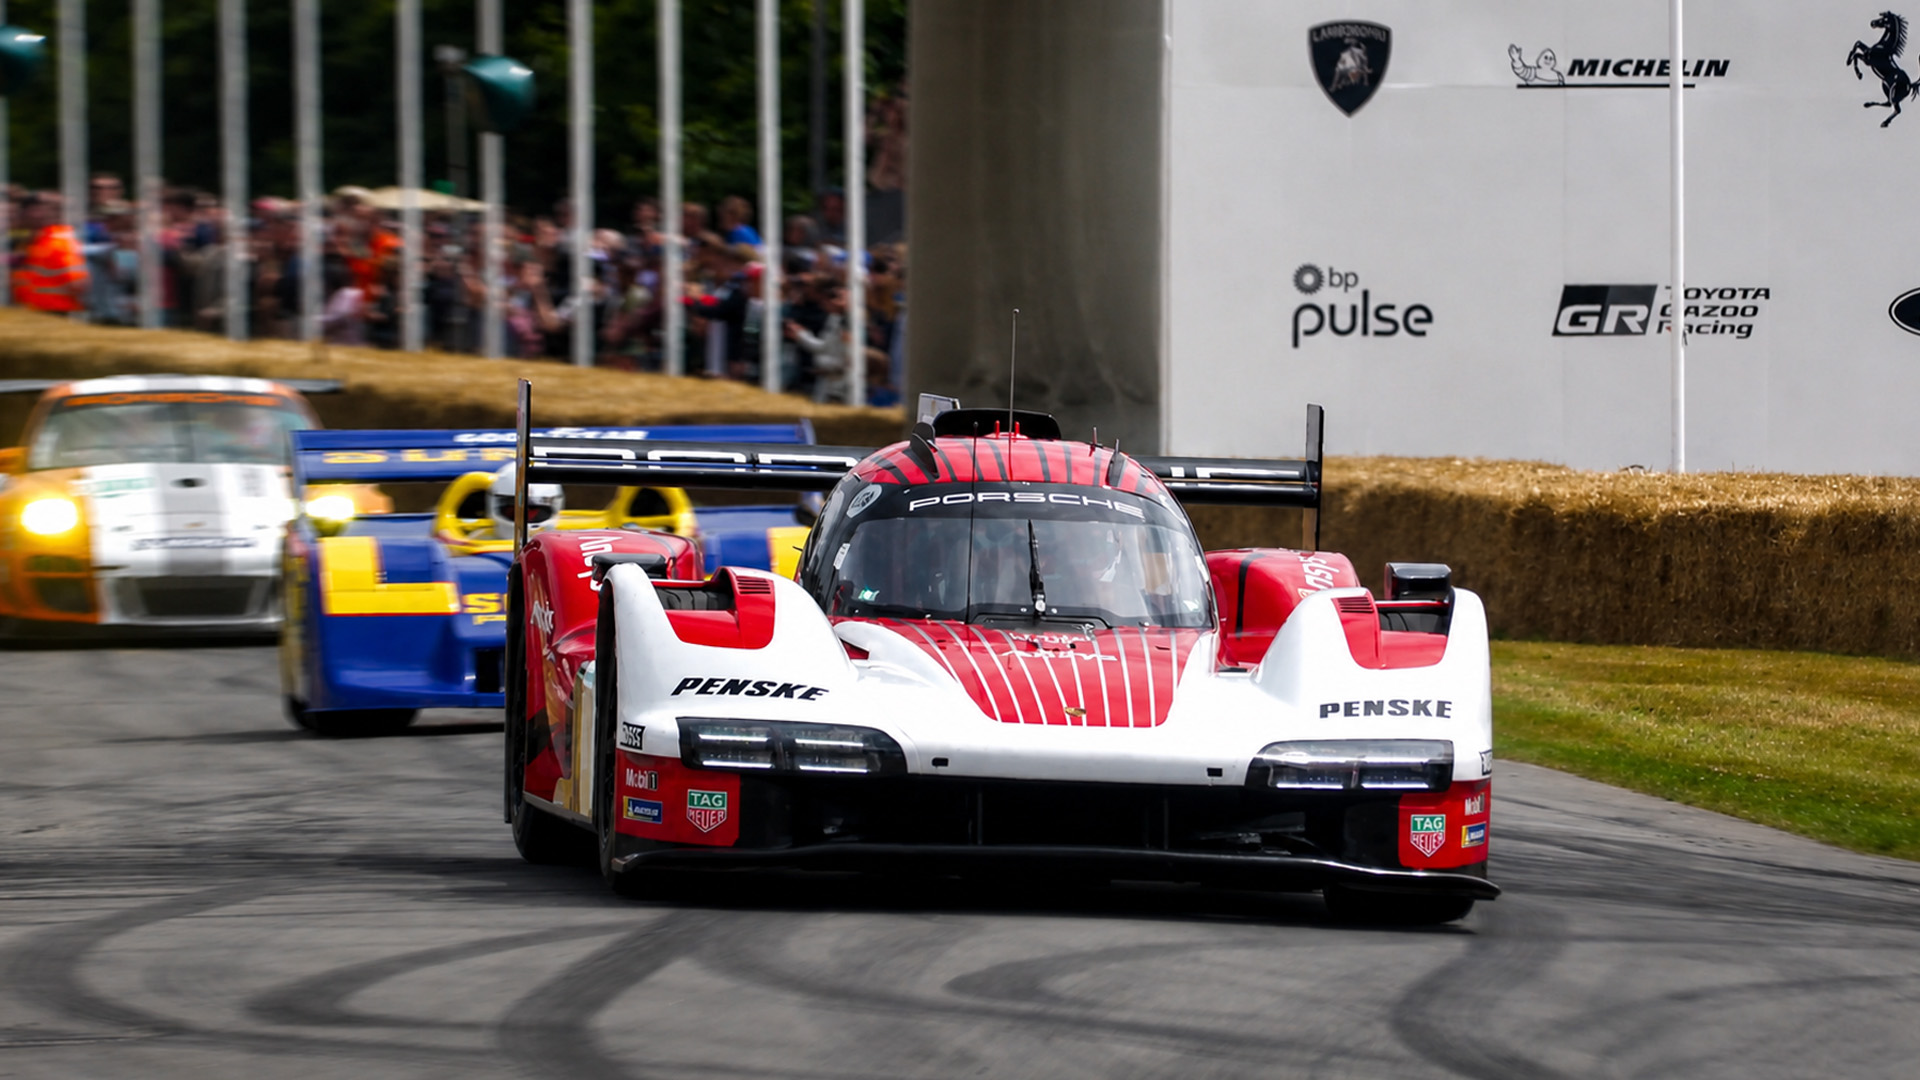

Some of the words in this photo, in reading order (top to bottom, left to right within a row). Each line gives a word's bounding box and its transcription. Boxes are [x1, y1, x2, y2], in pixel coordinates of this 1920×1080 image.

[1328, 266, 1359, 293] bp
[1292, 289, 1433, 349] pulse
[1556, 304, 1649, 334] GR
[909, 492, 1145, 522] PORSCHE
[671, 677, 829, 701] PENSKE
[1319, 699, 1453, 719] PENSKE
[691, 792, 723, 807] TAG
[688, 808, 725, 830] HEUER
[1414, 817, 1442, 830] TAG
[1412, 833, 1443, 853] HEUER
